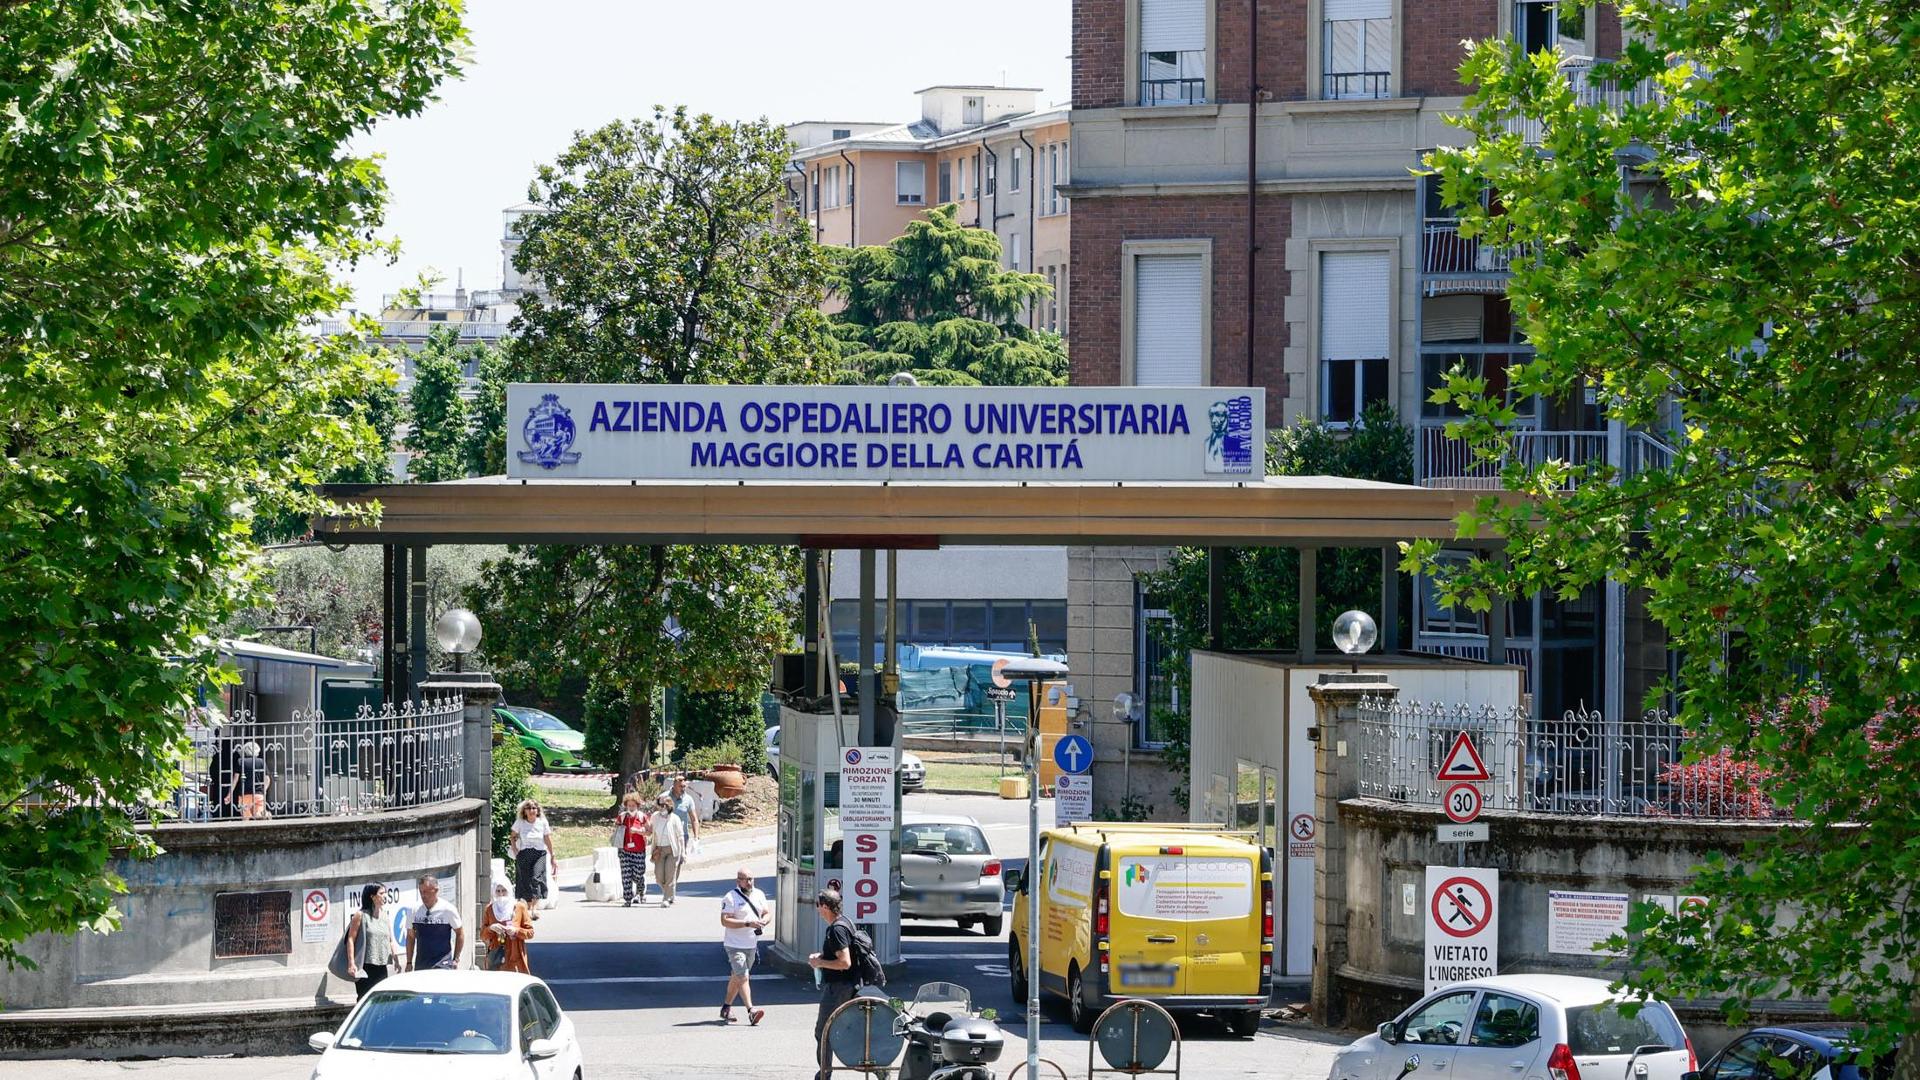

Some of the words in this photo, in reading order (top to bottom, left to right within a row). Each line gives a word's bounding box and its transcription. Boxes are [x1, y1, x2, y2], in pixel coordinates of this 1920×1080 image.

[589, 401, 728, 433] AZIENDA
[740, 402, 952, 435] OSPEDALIERO
[964, 403, 1190, 435] UNIVERSITARIA
[1239, 396, 1252, 450] AVOGADRO
[690, 442, 857, 468] MAGGIORE
[866, 443, 965, 469] DELLA
[972, 439, 1084, 469] CARITÁ
[1454, 793, 1472, 812] 30
[1452, 829, 1474, 837] serie
[855, 834, 879, 919] STOP
[1434, 945, 1488, 961] VIETATO
[1429, 965, 1493, 982] L'INGRESSO
